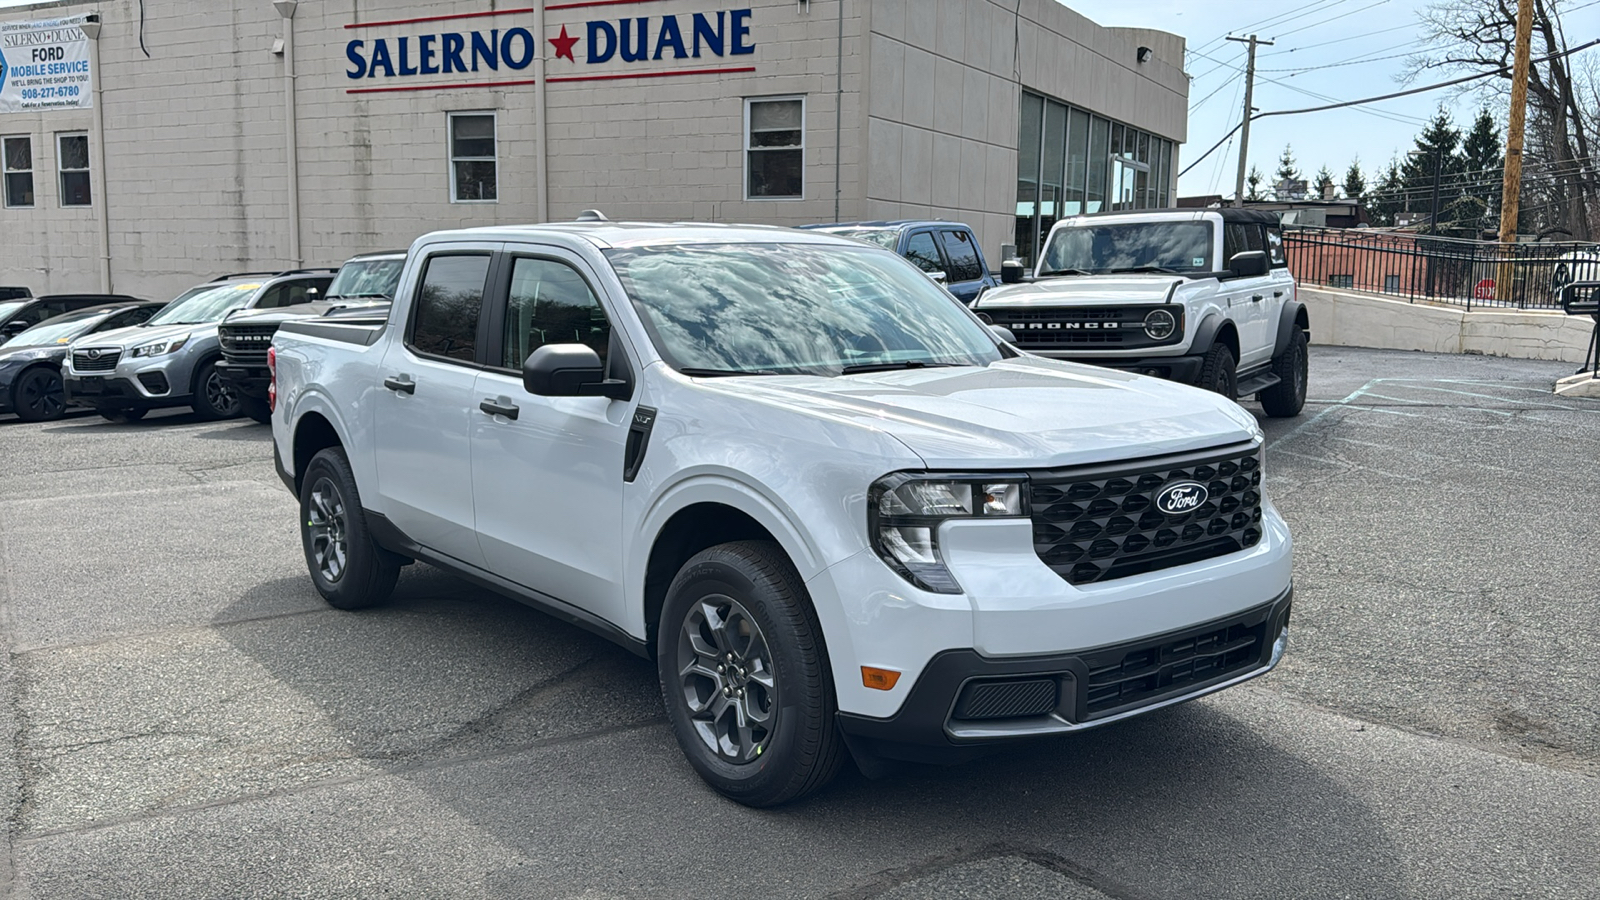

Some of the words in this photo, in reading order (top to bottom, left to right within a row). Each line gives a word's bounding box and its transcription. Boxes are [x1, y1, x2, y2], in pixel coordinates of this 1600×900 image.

[4, 31, 46, 47] SALERNO
[51, 27, 86, 43] DUANE
[345, 27, 535, 79] SALERNO
[586, 9, 757, 64] DUANE
[32, 46, 64, 62] FORD
[11, 64, 46, 78] MOBILE
[47, 60, 88, 74] SERVICE
[11, 79, 26, 87] WE'LL
[27, 78, 42, 86] BRING
[43, 77, 53, 85] THE
[54, 76, 67, 84] SHOP
[69, 75, 75, 83] TO
[21, 85, 79, 99] 908-277-6780
[1167, 487, 1199, 510] Ford
